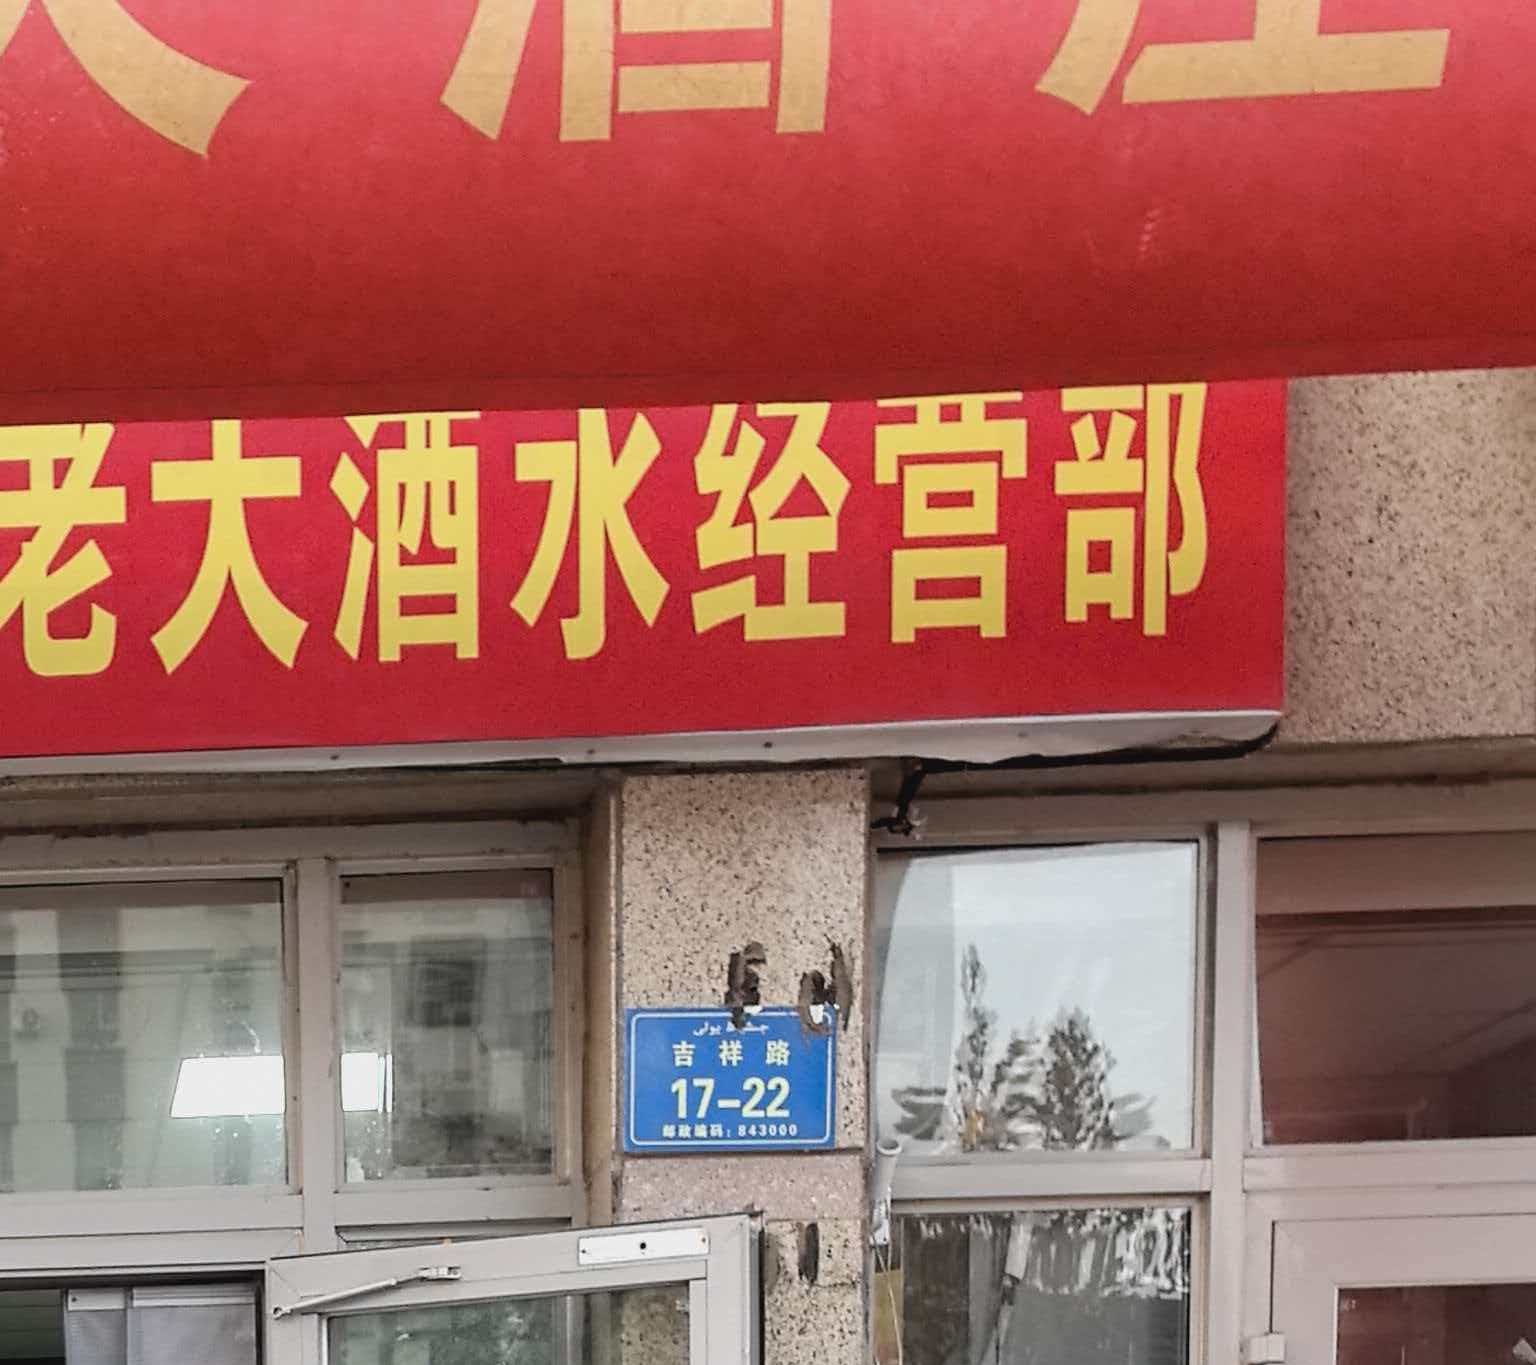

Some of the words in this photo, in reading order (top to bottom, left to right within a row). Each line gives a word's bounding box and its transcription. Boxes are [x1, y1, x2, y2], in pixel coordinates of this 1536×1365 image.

[672, 1040, 791, 1067] 吉祥路
[670, 1076, 791, 1120] 17-22
